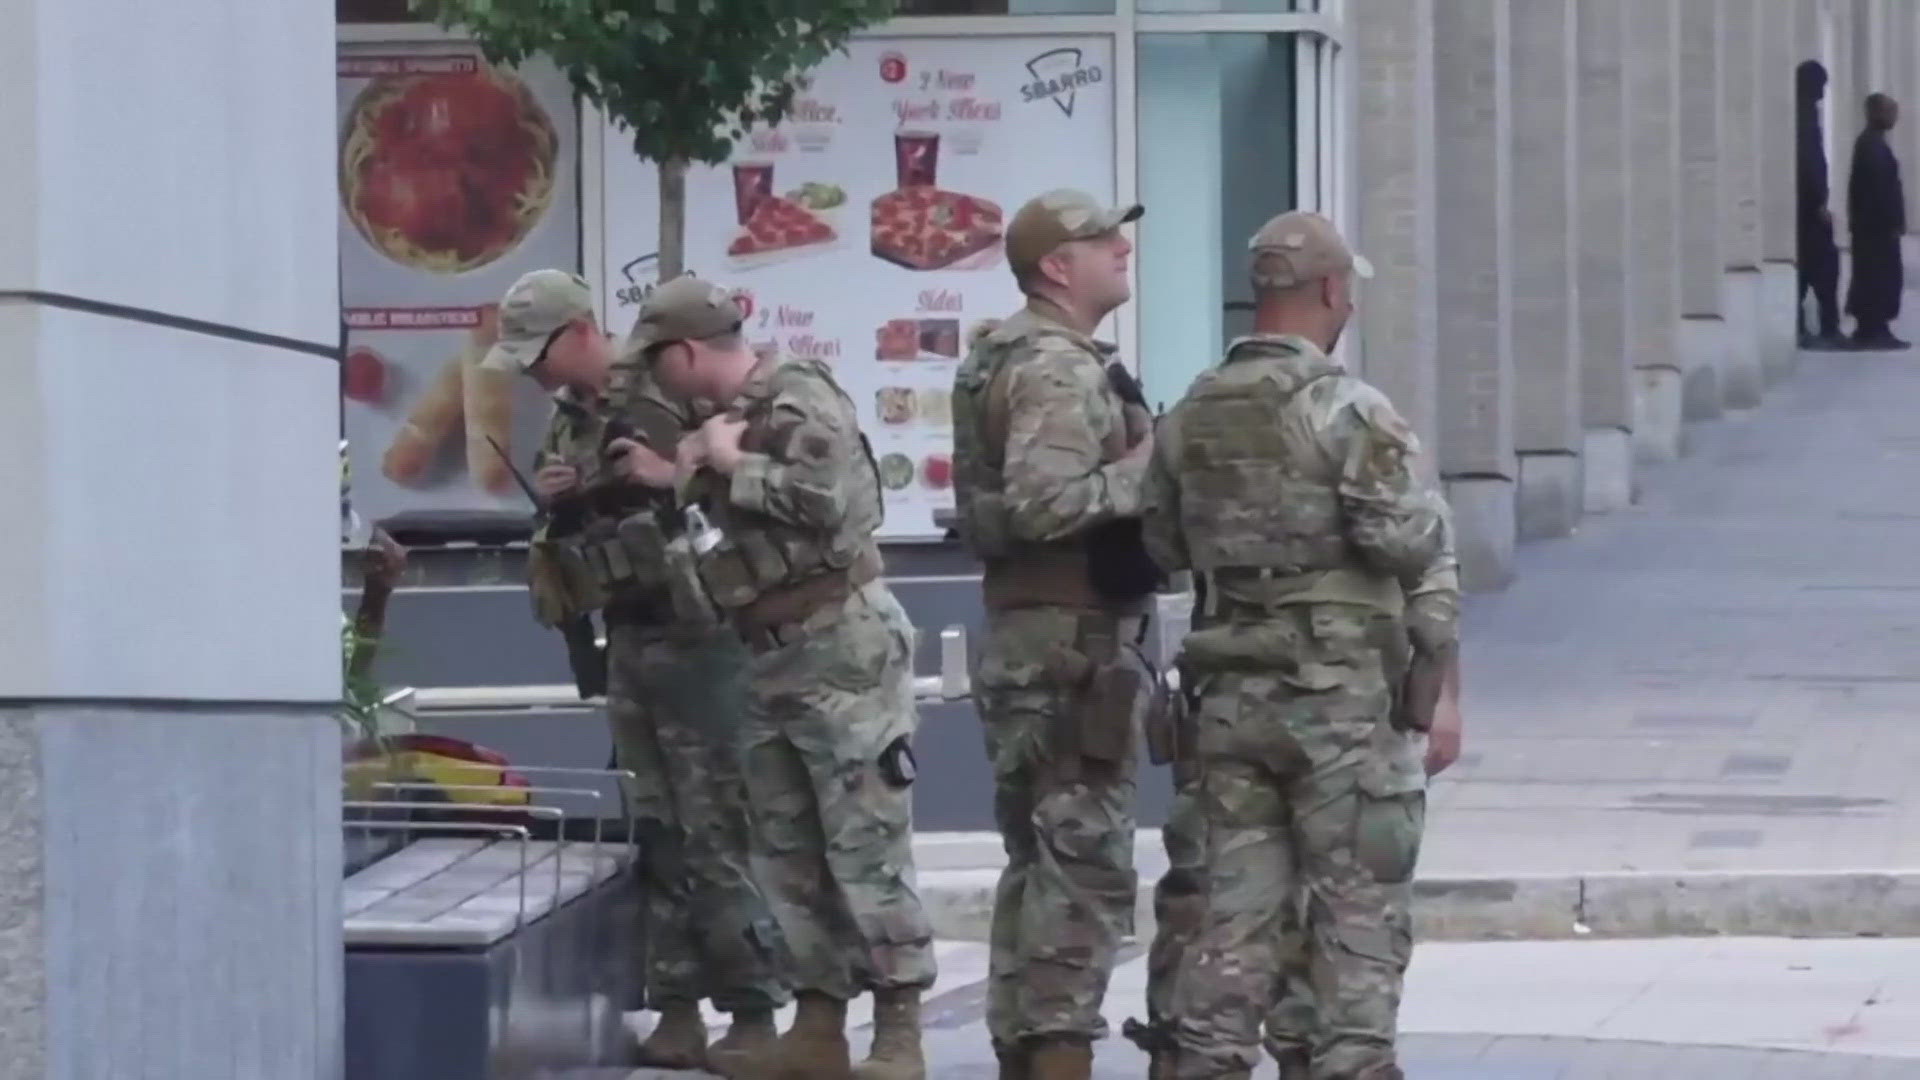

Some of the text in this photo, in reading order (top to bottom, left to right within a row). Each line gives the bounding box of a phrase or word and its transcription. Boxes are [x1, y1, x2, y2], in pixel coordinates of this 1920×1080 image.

[937, 68, 975, 90] New
[1019, 65, 1102, 103] SBARRO
[891, 97, 939, 126] York
[776, 305, 815, 328] New
